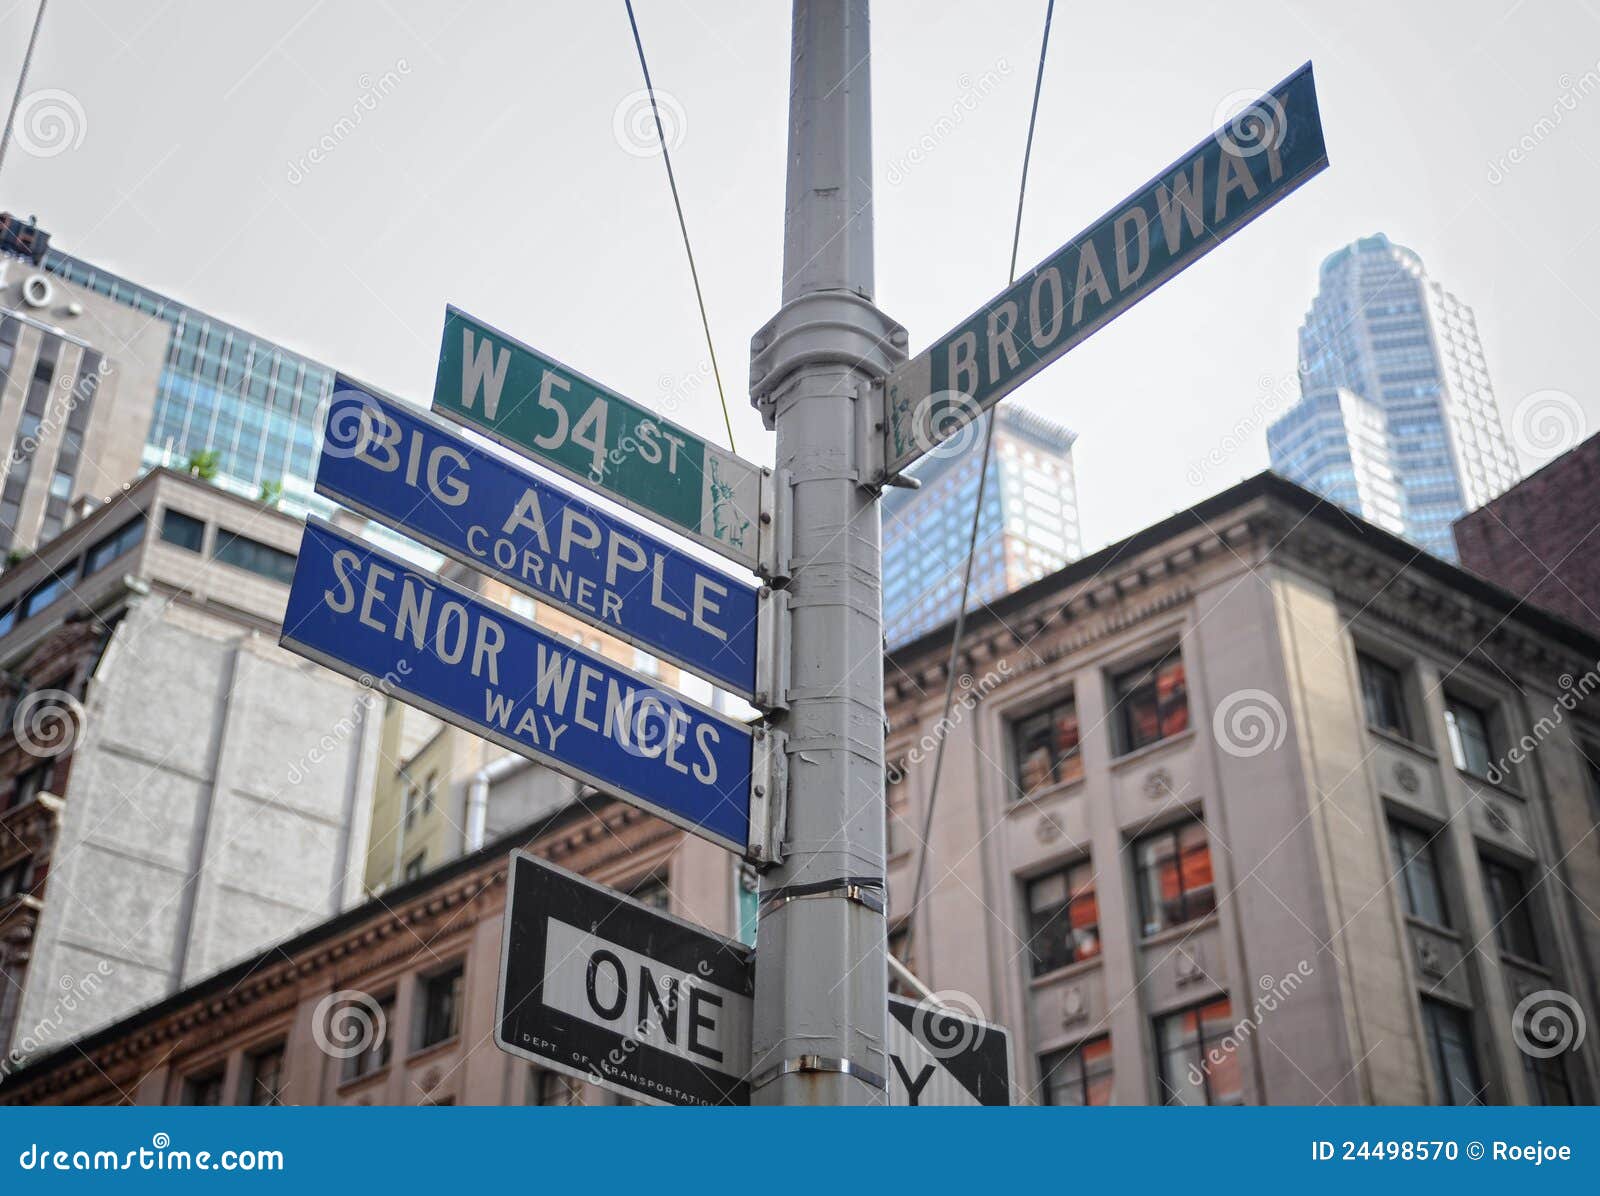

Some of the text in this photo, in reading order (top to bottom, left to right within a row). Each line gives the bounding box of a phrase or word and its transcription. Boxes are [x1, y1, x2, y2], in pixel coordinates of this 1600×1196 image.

[948, 91, 1289, 411] BROADWAY
[461, 327, 686, 475] W 54 ST
[354, 404, 728, 642] BIG APPLE
[466, 525, 623, 625] CORNER
[324, 549, 720, 785] SEÑOR WENCES
[485, 687, 568, 751] WAY
[523, 1033, 718, 1106] DEPT OF TRANSPORTATIO
[586, 949, 723, 1064] ONE
